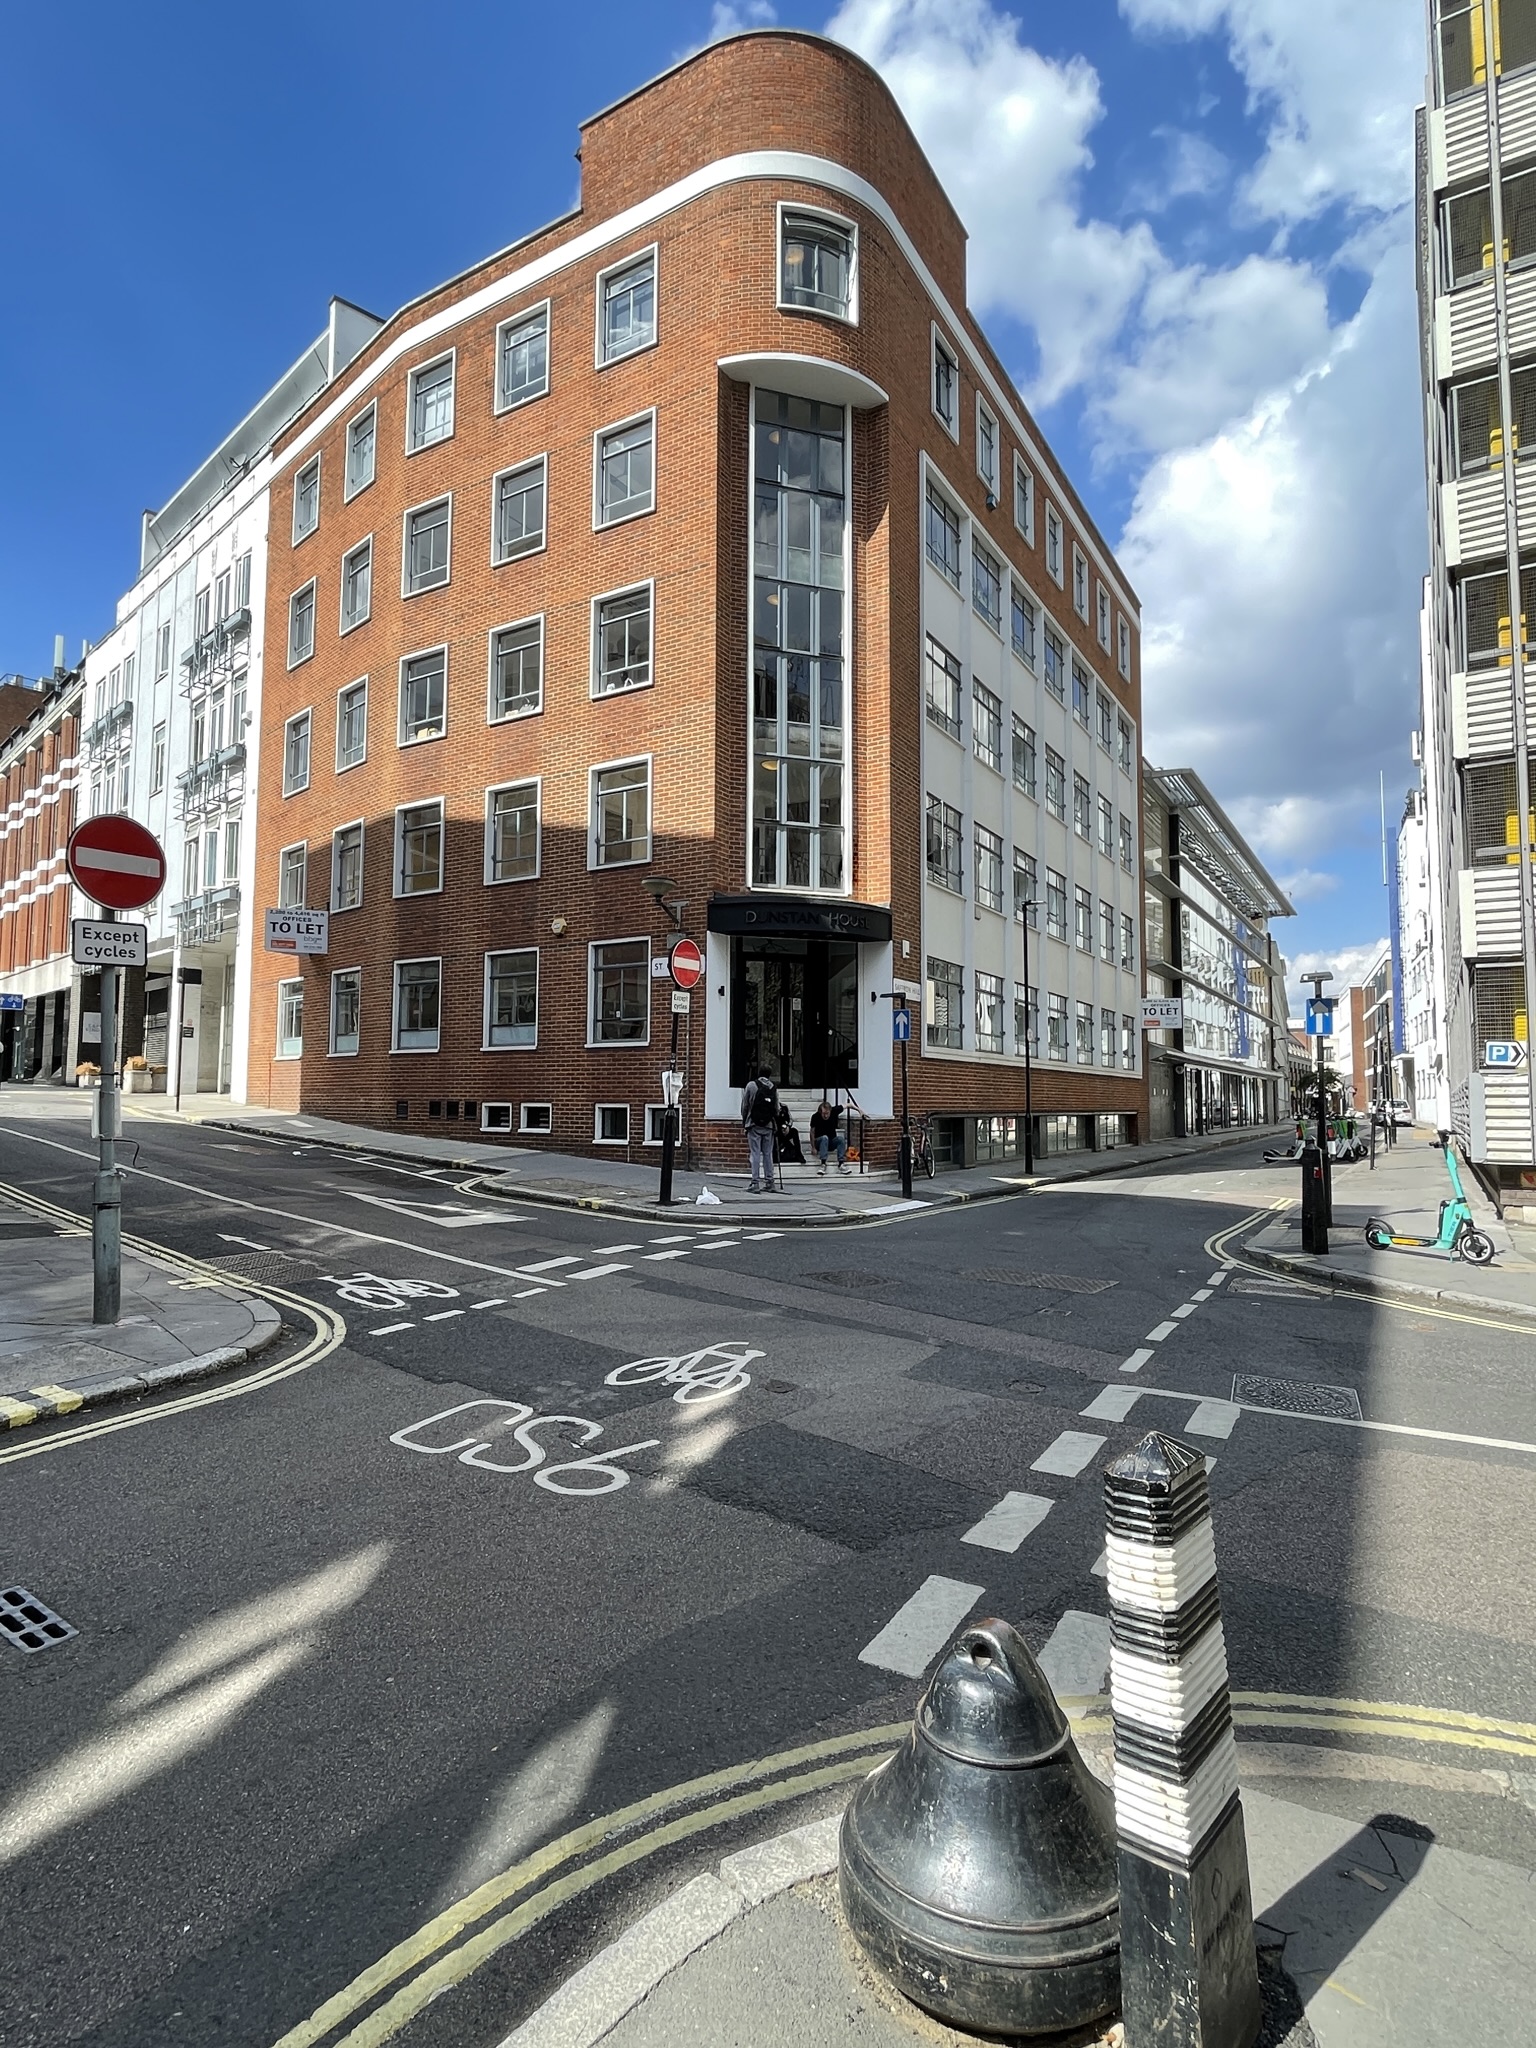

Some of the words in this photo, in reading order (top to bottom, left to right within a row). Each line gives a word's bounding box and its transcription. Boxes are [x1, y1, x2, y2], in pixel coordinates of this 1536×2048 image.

[746, 910, 820, 924] DUNSTAN
[82, 926, 139, 944] Except
[269, 921, 291, 933] TO
[296, 922, 324, 935] LET
[84, 945, 136, 959] cycles
[673, 993, 688, 1002] Except
[1142, 1007, 1157, 1016] TO
[1160, 1007, 1178, 1016] LET
[1492, 1046, 1506, 1060] P
